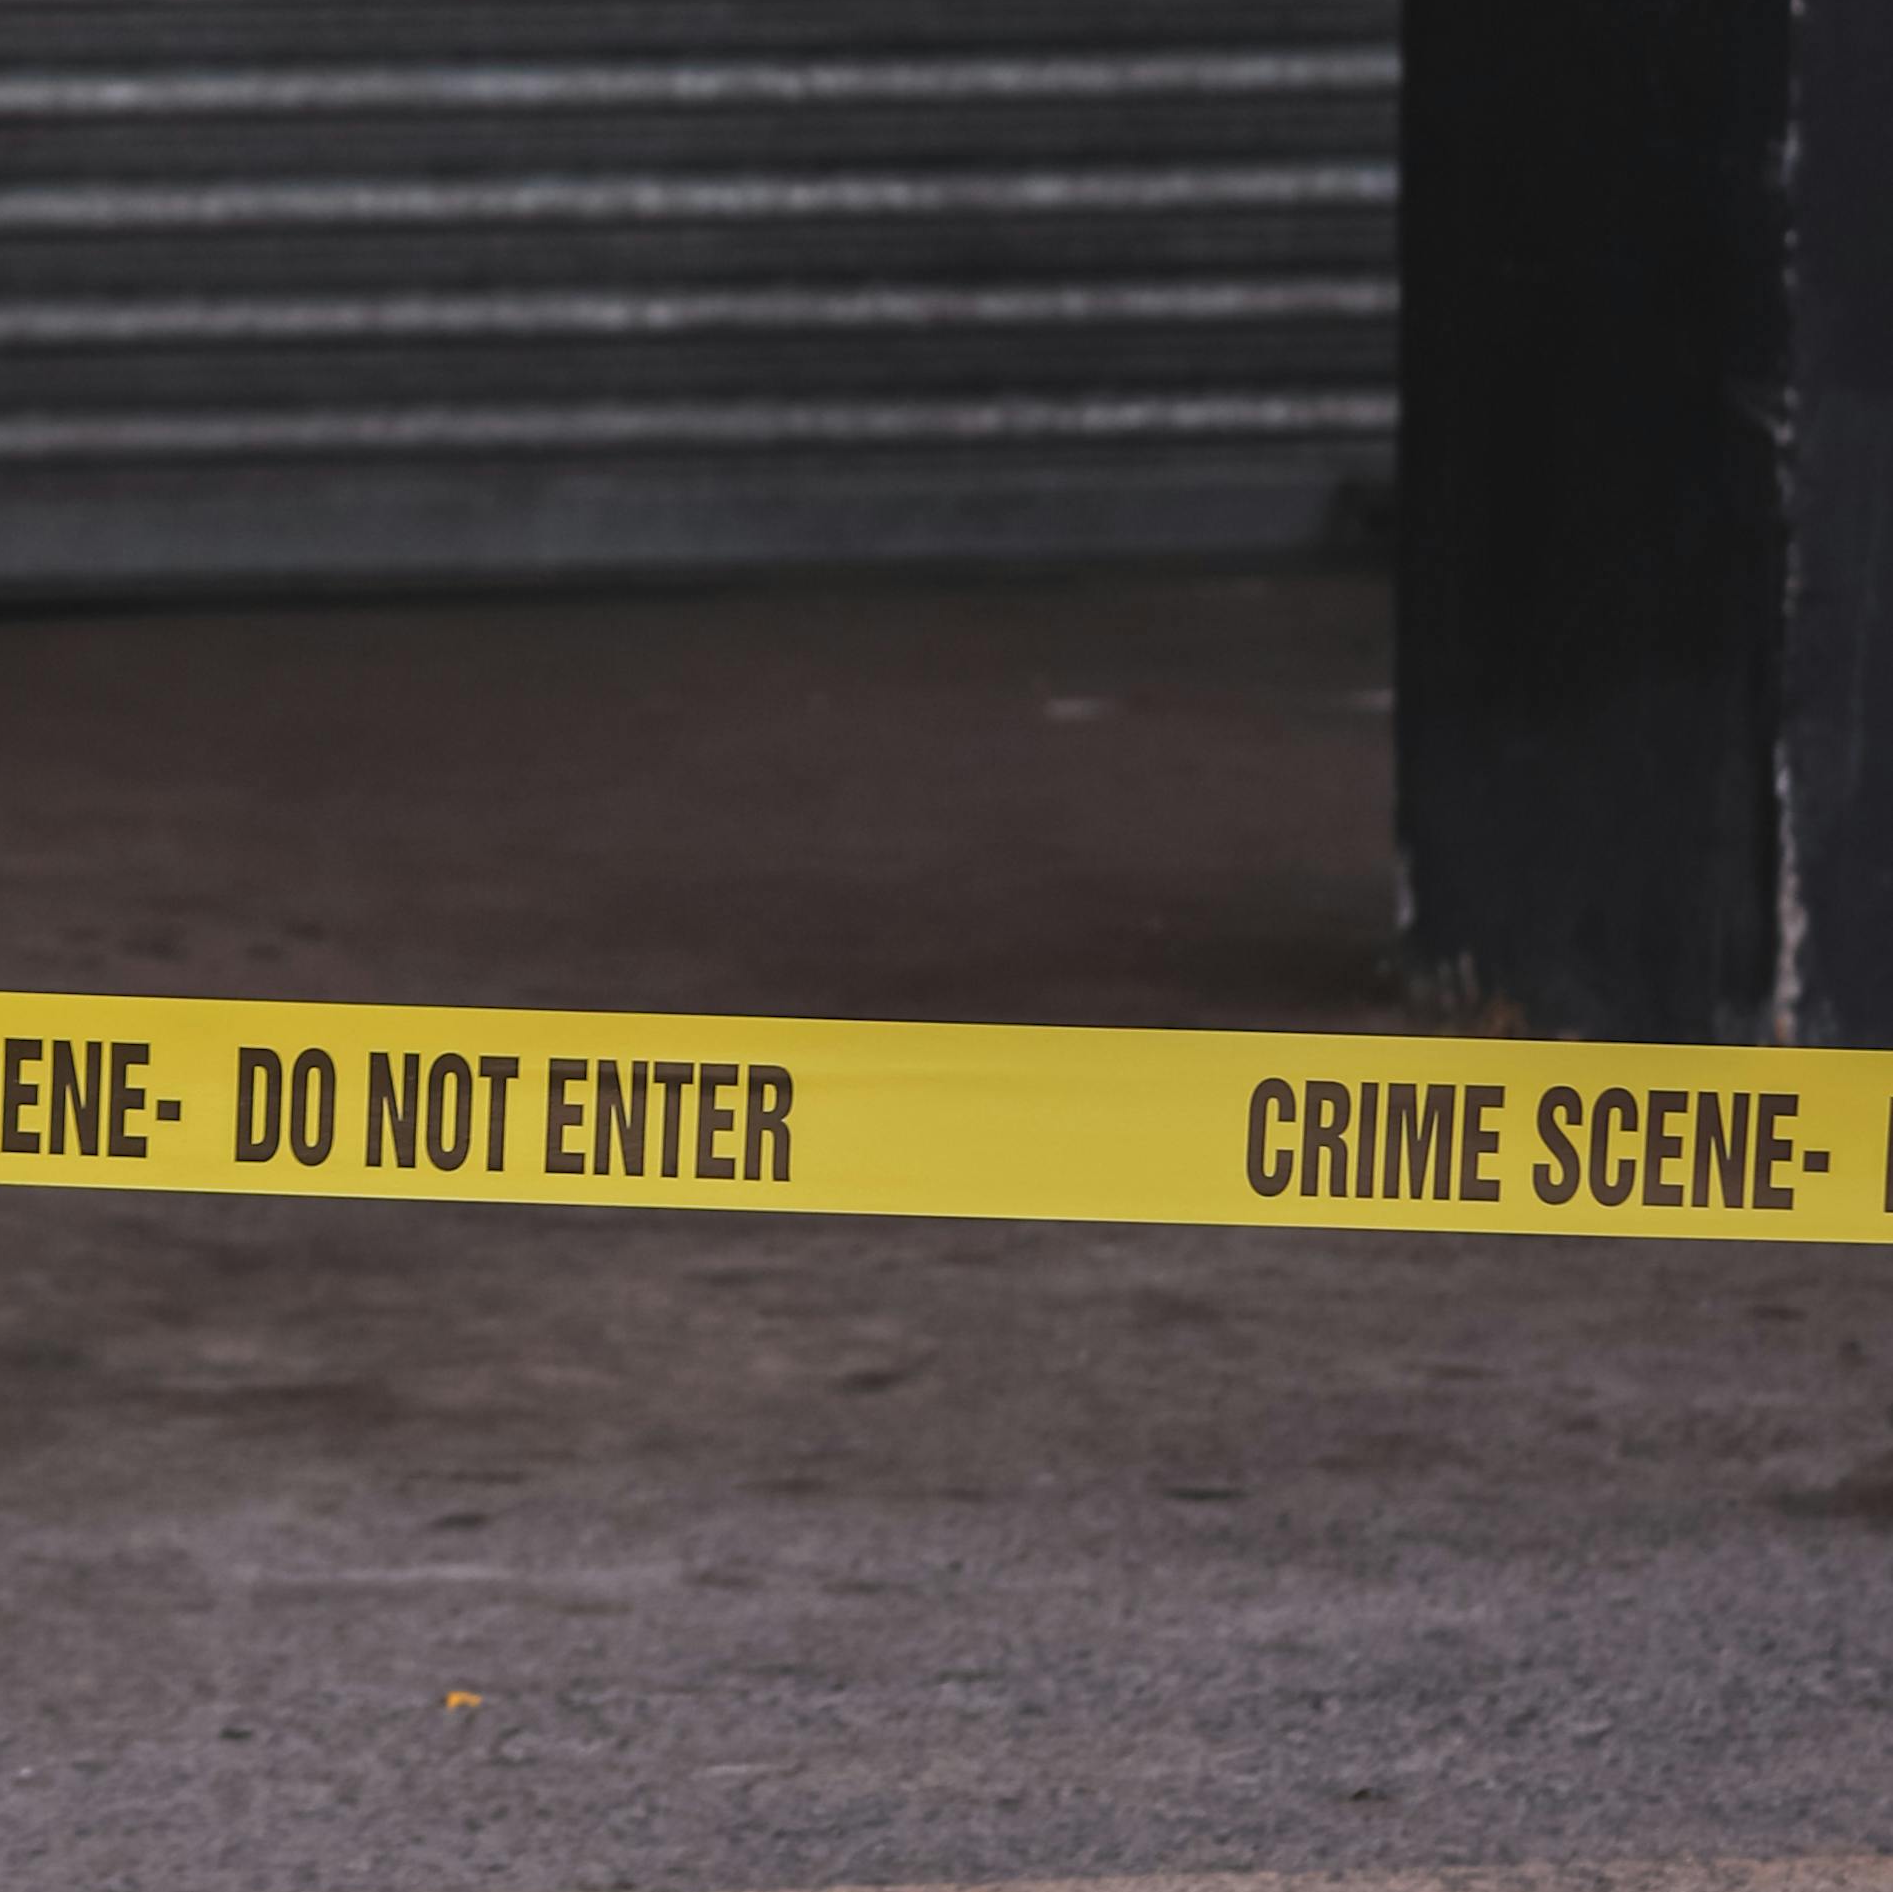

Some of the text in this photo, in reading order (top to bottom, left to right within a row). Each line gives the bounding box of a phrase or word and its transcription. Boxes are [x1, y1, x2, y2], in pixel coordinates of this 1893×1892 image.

[234, 1047, 337, 1167] DO
[365, 1052, 519, 1172] NOT
[544, 1058, 793, 1182] ENTER
[1246, 1078, 1505, 1202] CRIME
[1532, 1085, 1830, 1210] SCENE-
